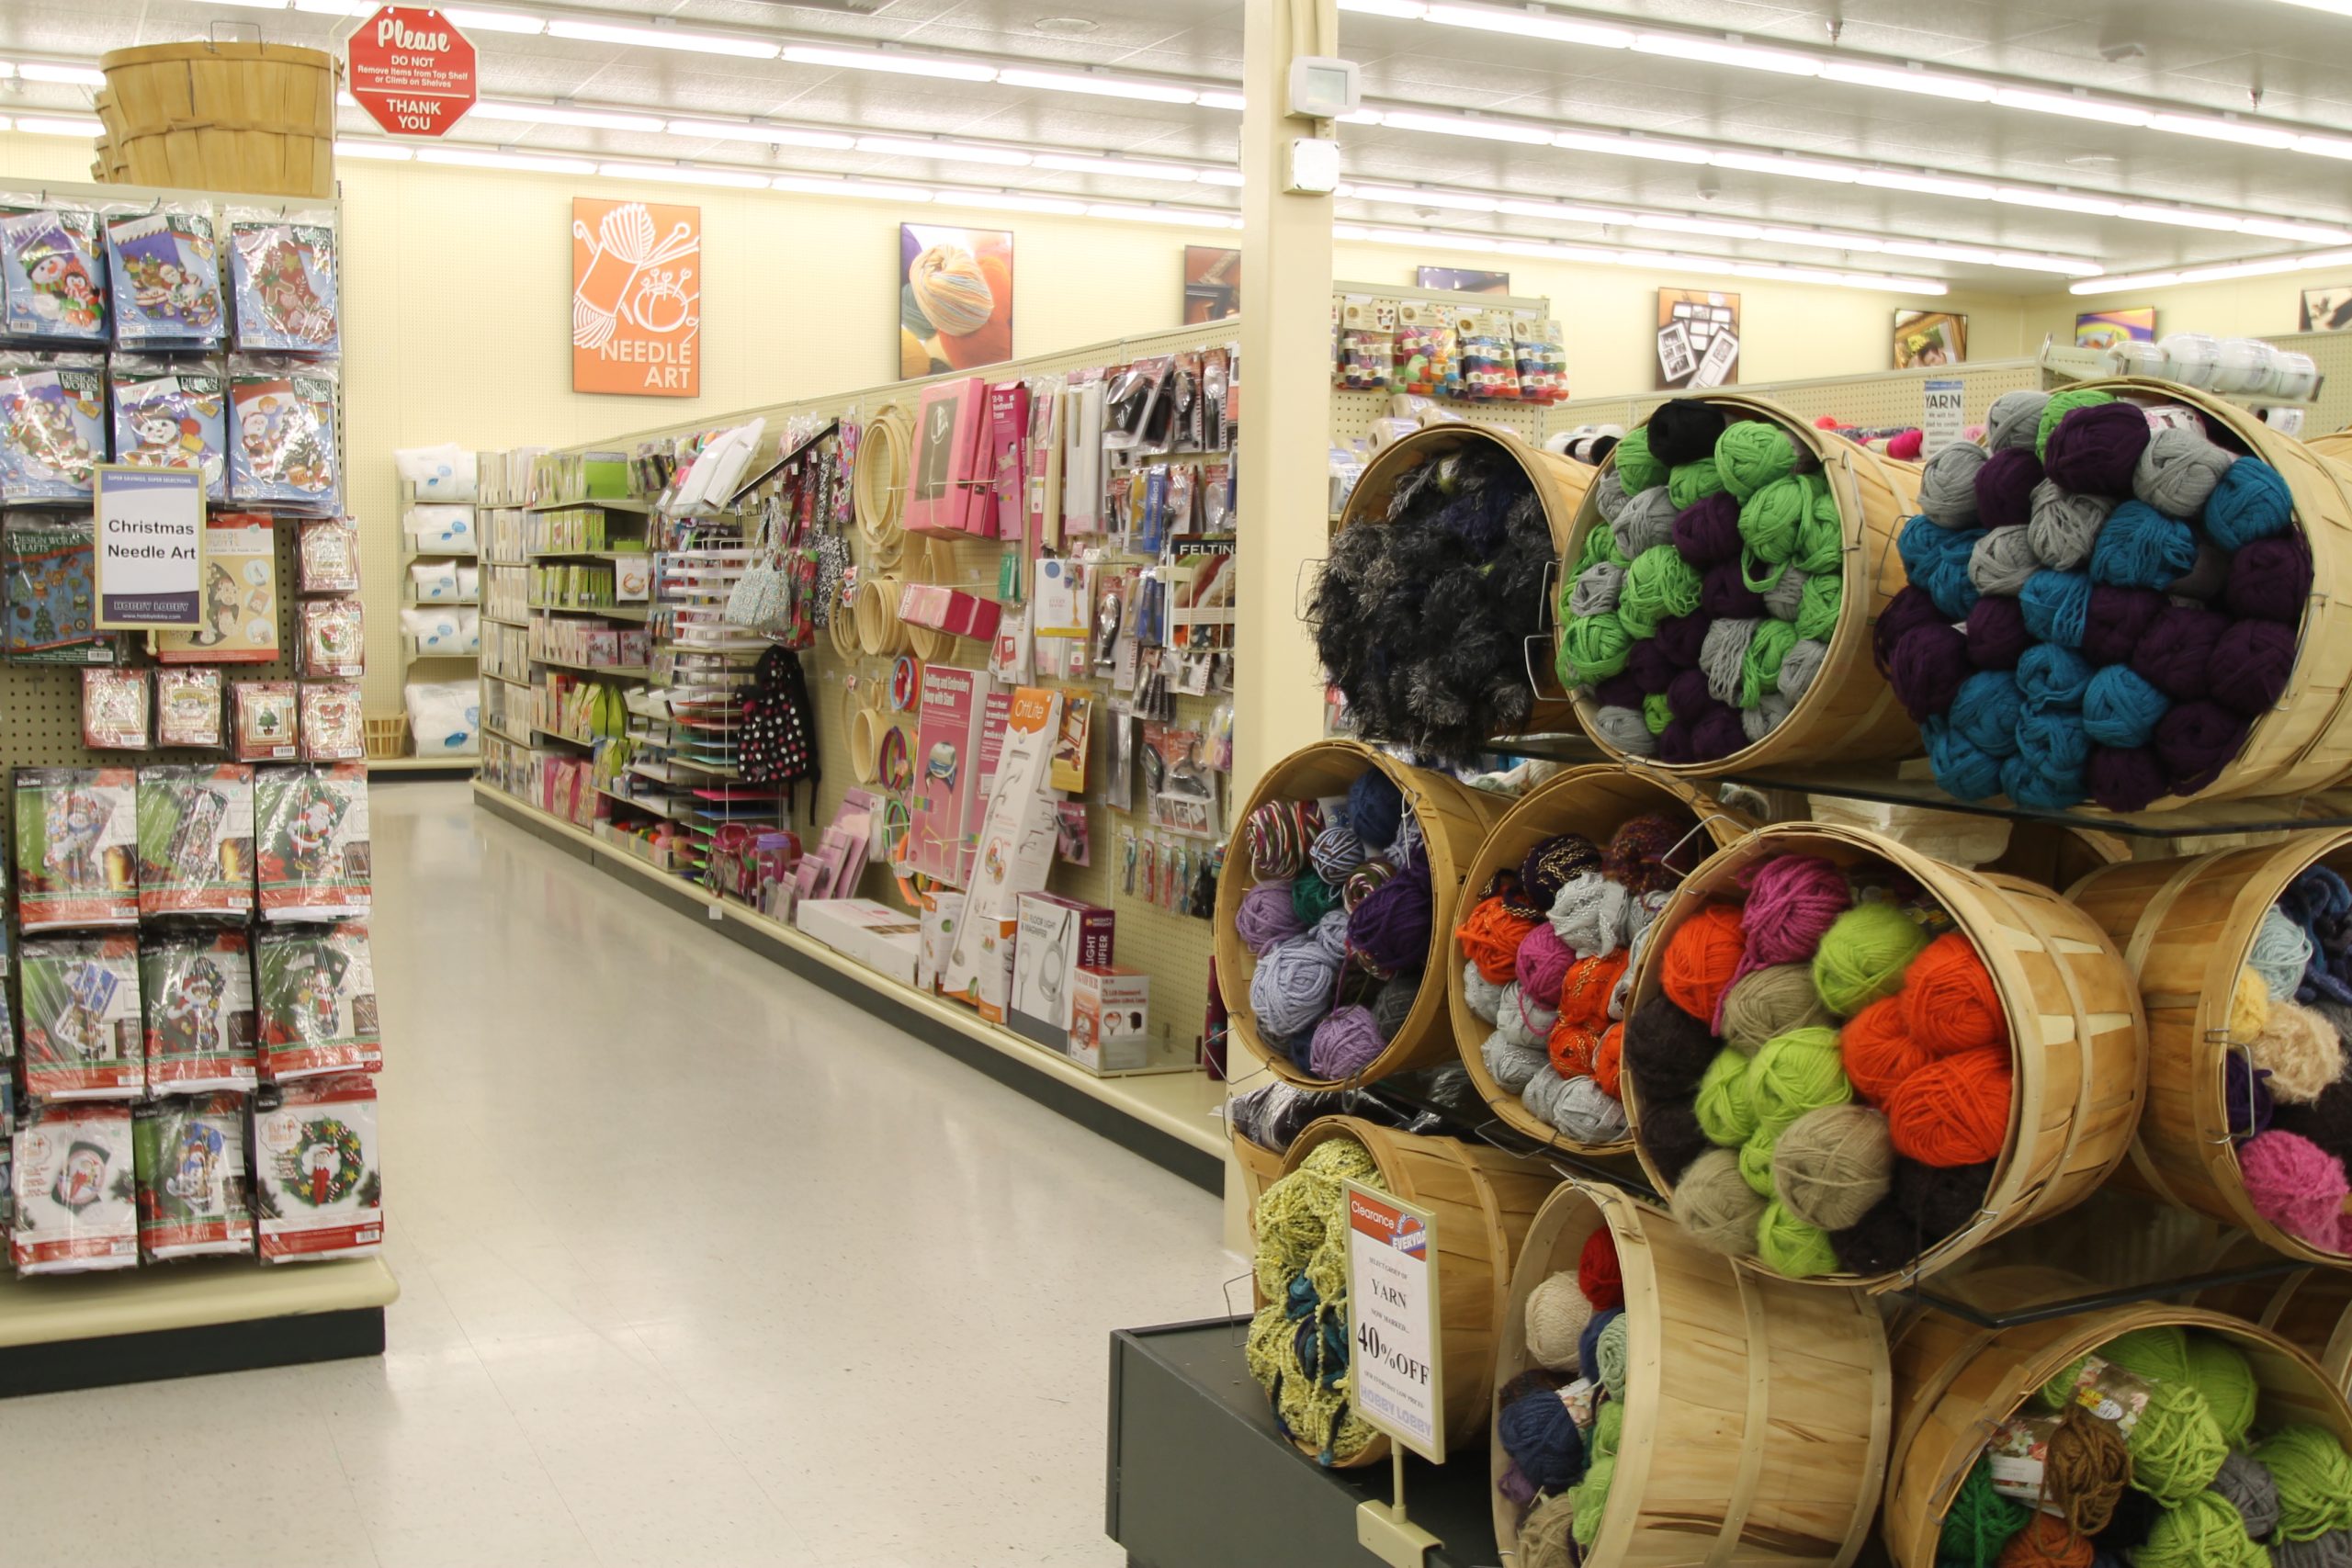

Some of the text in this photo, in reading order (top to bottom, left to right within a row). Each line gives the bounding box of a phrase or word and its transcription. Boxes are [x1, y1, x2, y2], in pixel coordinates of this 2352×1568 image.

[378, 18, 450, 52] Please
[391, 55, 435, 68] DO NOT
[357, 65, 389, 75] Remove
[413, 69, 431, 78] from
[433, 71, 447, 80] Top
[448, 72, 468, 80] Shelf
[386, 76, 408, 85] Climb
[422, 79, 451, 88] Shelves
[386, 99, 441, 115] THANK
[398, 116, 431, 130] YOU
[601, 340, 691, 365] NEEDLE
[61, 373, 98, 385] DESIGN
[643, 366, 691, 389] ART
[62, 382, 98, 392] WORKS
[1925, 394, 1961, 409] YARN
[108, 520, 194, 536] Christmas
[108, 545, 196, 559] Needle Art
[1180, 545, 1234, 556] FELTIN
[114, 601, 189, 612] HOBBY LOBBY
[1085, 934, 1096, 966] LIGHT
[1351, 1201, 1395, 1229] Clearance
[1392, 1230, 1426, 1250] EVERYDA
[1372, 1278, 1407, 1309] YARN
[1361, 1384, 1431, 1437] HOBBY LOBBY
